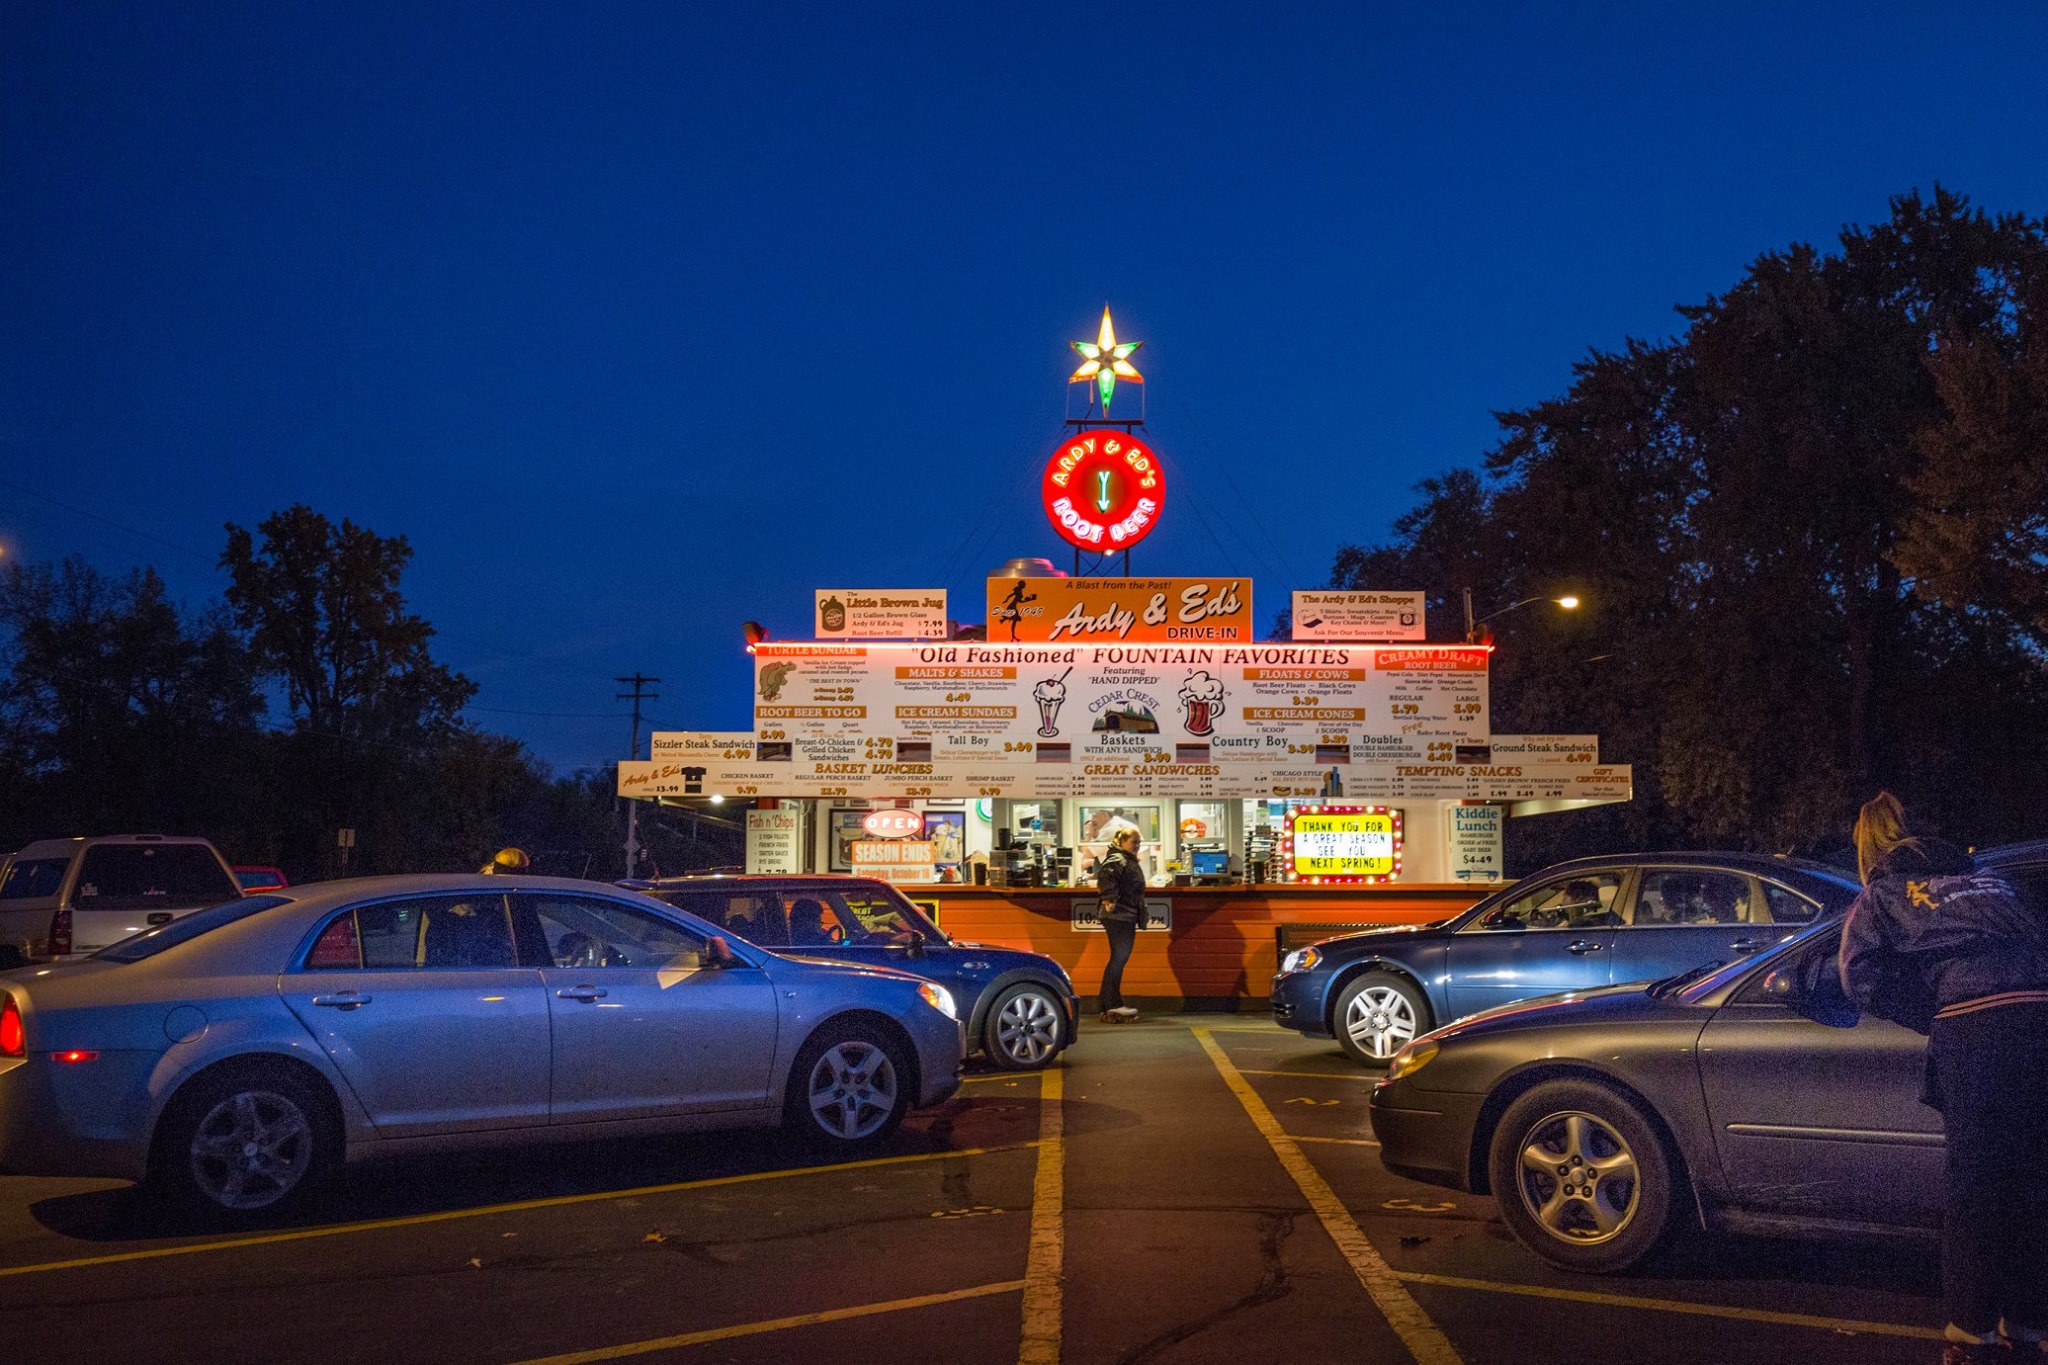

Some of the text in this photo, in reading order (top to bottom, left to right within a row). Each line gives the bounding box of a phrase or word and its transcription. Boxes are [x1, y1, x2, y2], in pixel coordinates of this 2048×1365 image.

[1051, 438, 1156, 488] ARDY & ED'S
[1052, 497, 1156, 543] ROOT BEER
[1065, 581, 1172, 589] A Blast from the Past!
[846, 598, 943, 609] Little Brown Jug
[1302, 595, 1320, 603] The
[1322, 595, 1345, 604] Ardy
[1358, 595, 1377, 603] Ed's
[1379, 595, 1415, 605] Shoppe
[991, 606, 1016, 616] Since
[1049, 582, 1242, 639] Ardy & Ed's
[1167, 627, 1237, 639] DRIVE-IN
[768, 647, 857, 655] TURTLE SUNDAE
[912, 647, 1349, 664] "Old Fashioned" FOUNTAIN FAVORITES
[1378, 650, 1484, 666] CREAMY DRAFT
[908, 668, 1003, 677] MALTS & SHAKES
[1103, 667, 1146, 675] Featuring
[1259, 670, 1350, 679] FLOATS & COWS
[1121, 676, 1160, 684] DIPPED"
[1088, 690, 1123, 713] CEDAR
[760, 708, 861, 717] ROOT BEER TO GO
[899, 708, 1014, 717] ICE CREAM SUNDAES
[1253, 710, 1355, 719] ICE CREAM CONES
[1401, 722, 1423, 735] Free
[654, 740, 755, 749] Sizzler Steak Sandwich
[795, 738, 855, 746] Breast-O-Chicken
[865, 737, 893, 747] 4.79
[947, 736, 989, 747] Tall Boy
[1101, 734, 1146, 745] Baskets
[1211, 736, 1288, 748] Country Boy
[1363, 735, 1403, 744] Doubles
[1492, 743, 1596, 752] Ground Steak Sandwich
[808, 753, 849, 761] Sandwiches
[865, 749, 893, 759] 4.79
[815, 763, 933, 774] BASKET LUNCHES
[1084, 765, 1220, 775] GREAT SANDWICHES
[1396, 766, 1522, 777] TEMPTING SNACKS
[1593, 768, 1613, 776] GIFT
[623, 773, 648, 787] Ardy
[1456, 808, 1498, 818] Kiddie
[749, 814, 764, 828] Fish
[867, 818, 919, 829] OPEN
[1456, 820, 1497, 831] Lunch
[1303, 822, 1383, 832] THANK YOU FOR
[1303, 834, 1385, 843] A GREAT SEASON
[855, 844, 931, 862] SEASON ENDS
[1318, 846, 1365, 856] SEE YOU
[1310, 858, 1381, 868] NEXT SPRING!
[1463, 854, 1492, 864] $4.49
